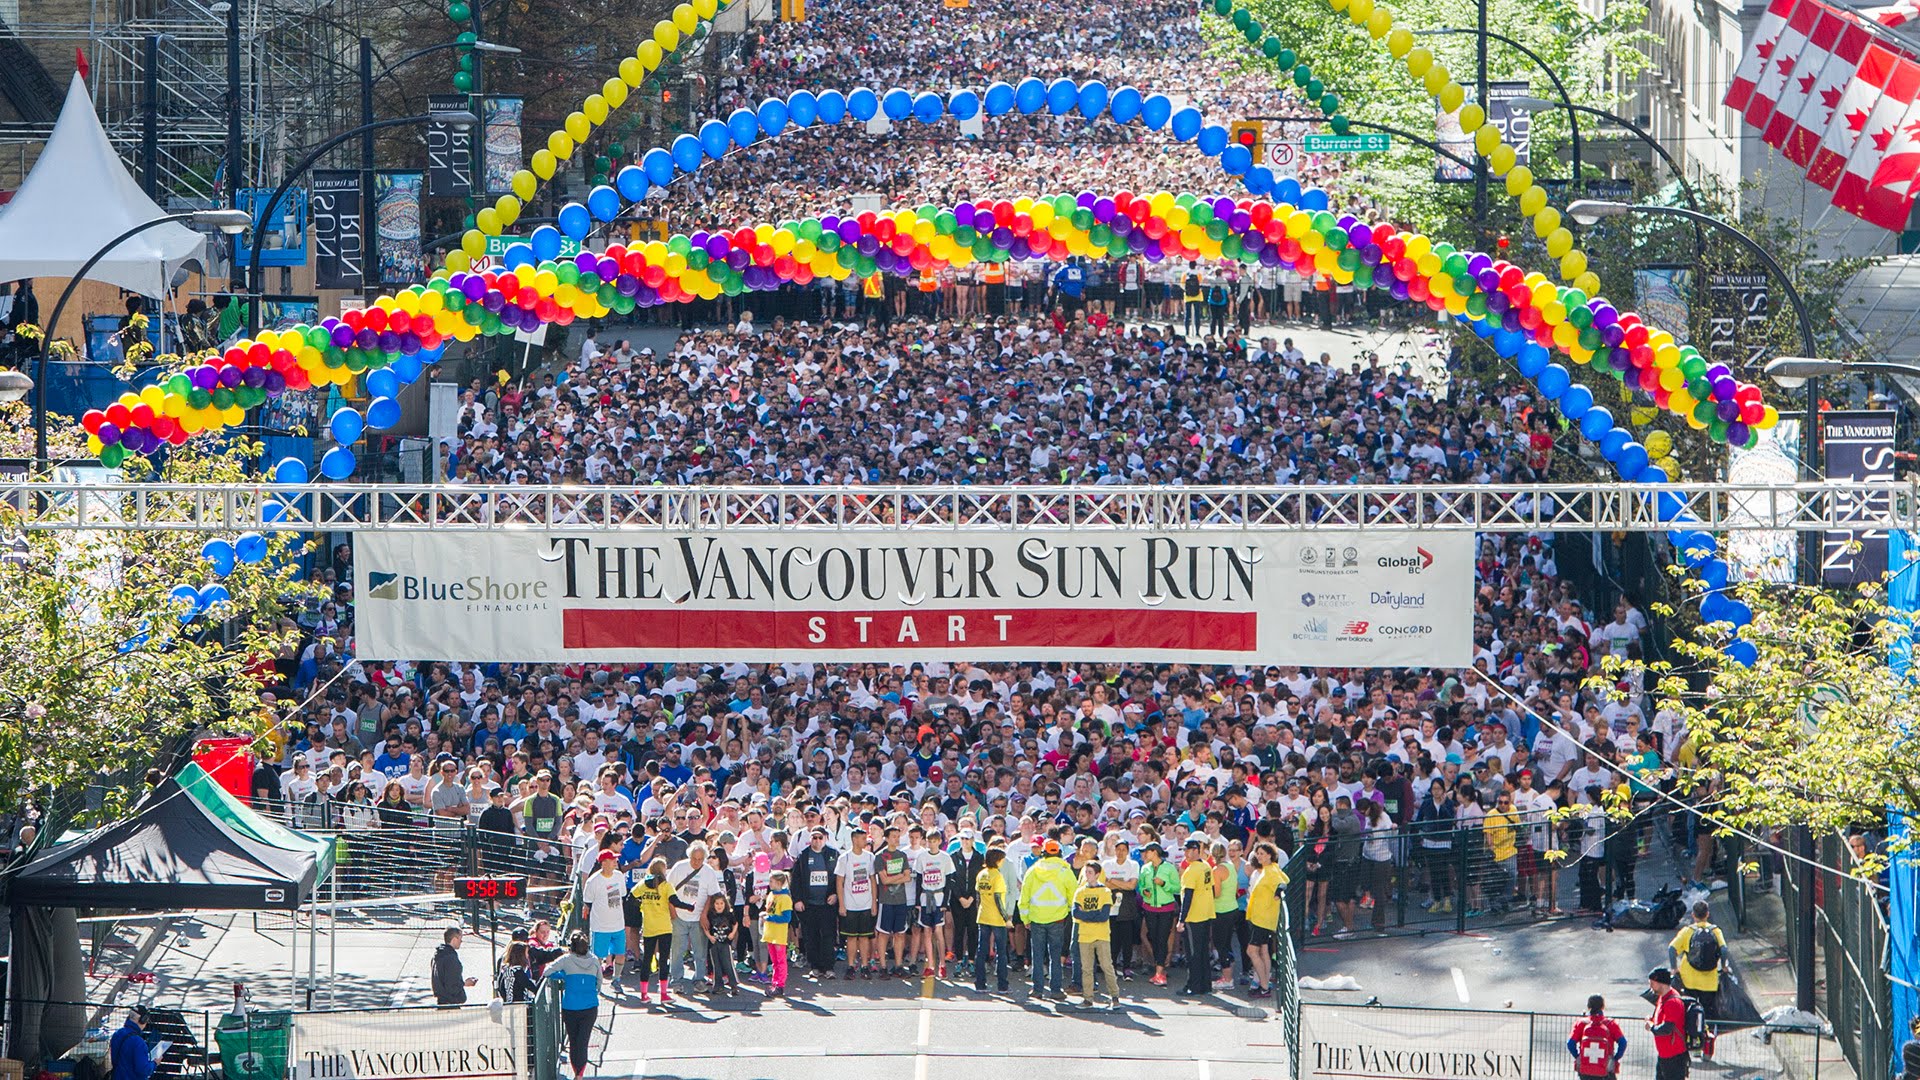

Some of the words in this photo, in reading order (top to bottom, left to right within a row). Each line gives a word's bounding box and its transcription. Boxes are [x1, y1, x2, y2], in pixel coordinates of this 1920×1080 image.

[1311, 138, 1361, 149] Burrard
[1368, 137, 1383, 149] St
[1711, 318, 1735, 375] RU
[1826, 425, 1843, 437] THE
[1844, 425, 1893, 437] VANCOUVER
[551, 537, 663, 599] THE
[674, 536, 1001, 601] VANCOUVER
[1016, 537, 1126, 599] SUN
[1141, 537, 1259, 602] RUN
[1378, 556, 1420, 567] Global
[404, 576, 548, 601] BlueShore
[467, 602, 548, 612] FINANCIAL
[1371, 591, 1425, 609] Dairyland
[808, 615, 1013, 644] START
[1378, 625, 1433, 635] CONCORD
[811, 875, 828, 883] 24241
[467, 880, 518, 897] 9:58:16
[305, 1051, 347, 1078] THE
[351, 1048, 473, 1077] VANCOUVER
[477, 1044, 517, 1072] SUN
[1313, 1042, 1353, 1070] THE
[1358, 1044, 1478, 1077] VANCOUVER
[1483, 1049, 1523, 1078] SUN
